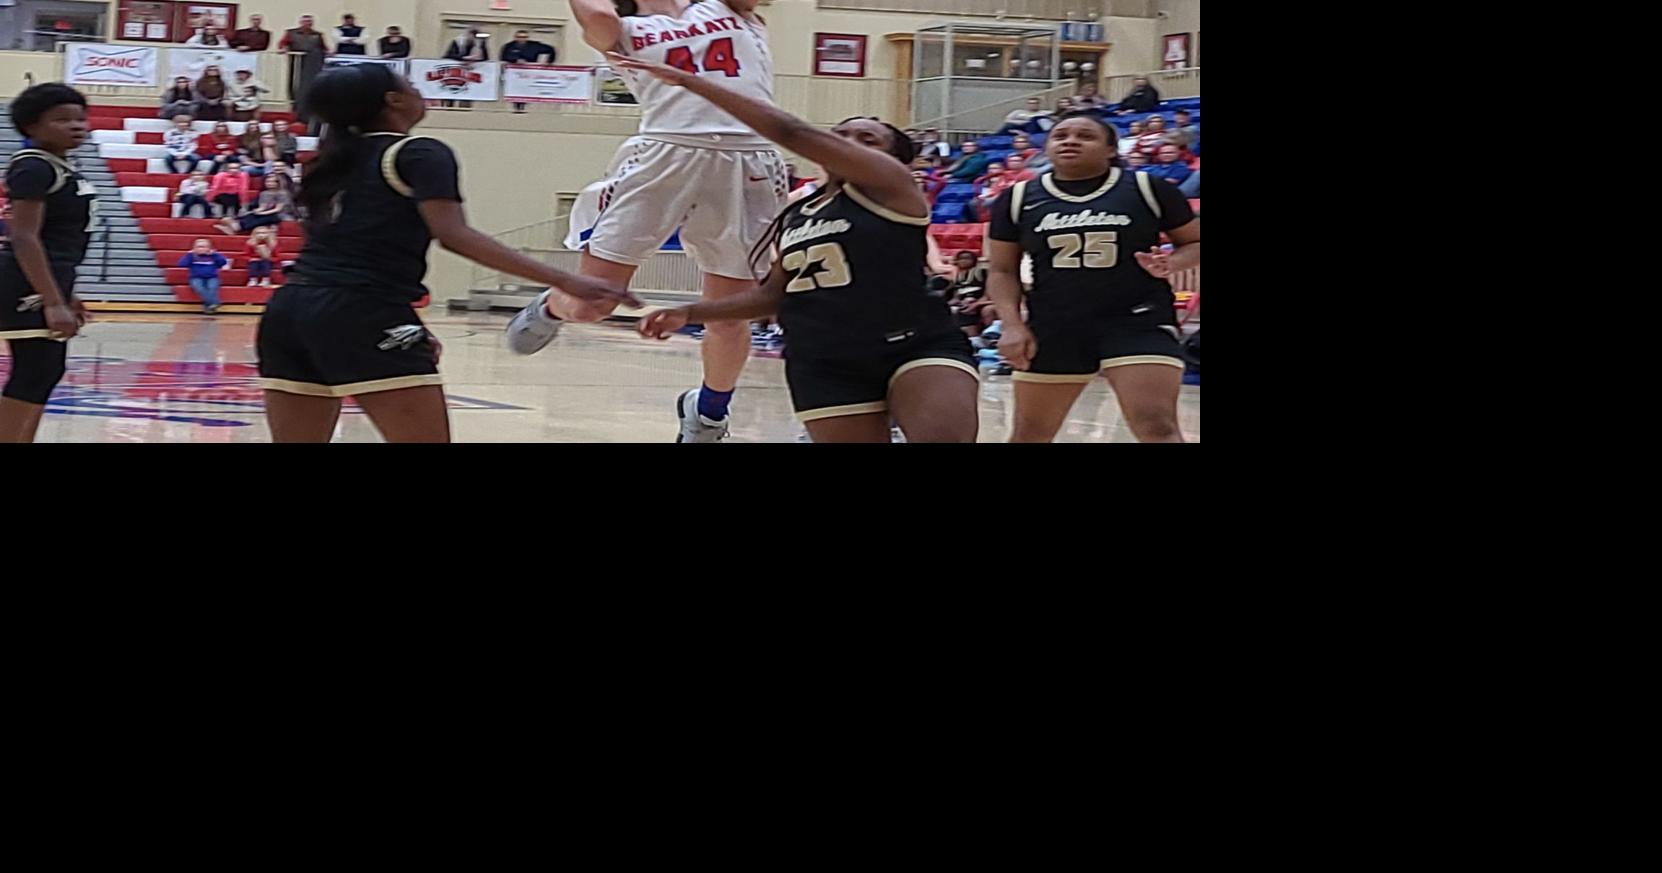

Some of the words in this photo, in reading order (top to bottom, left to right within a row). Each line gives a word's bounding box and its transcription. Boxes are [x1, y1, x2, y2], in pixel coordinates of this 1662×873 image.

[631, 16, 743, 50] BEARKATZ
[84, 56, 140, 69] SONIC
[665, 37, 741, 77] 44
[782, 242, 852, 293] 23
[1047, 231, 1118, 268] 25
